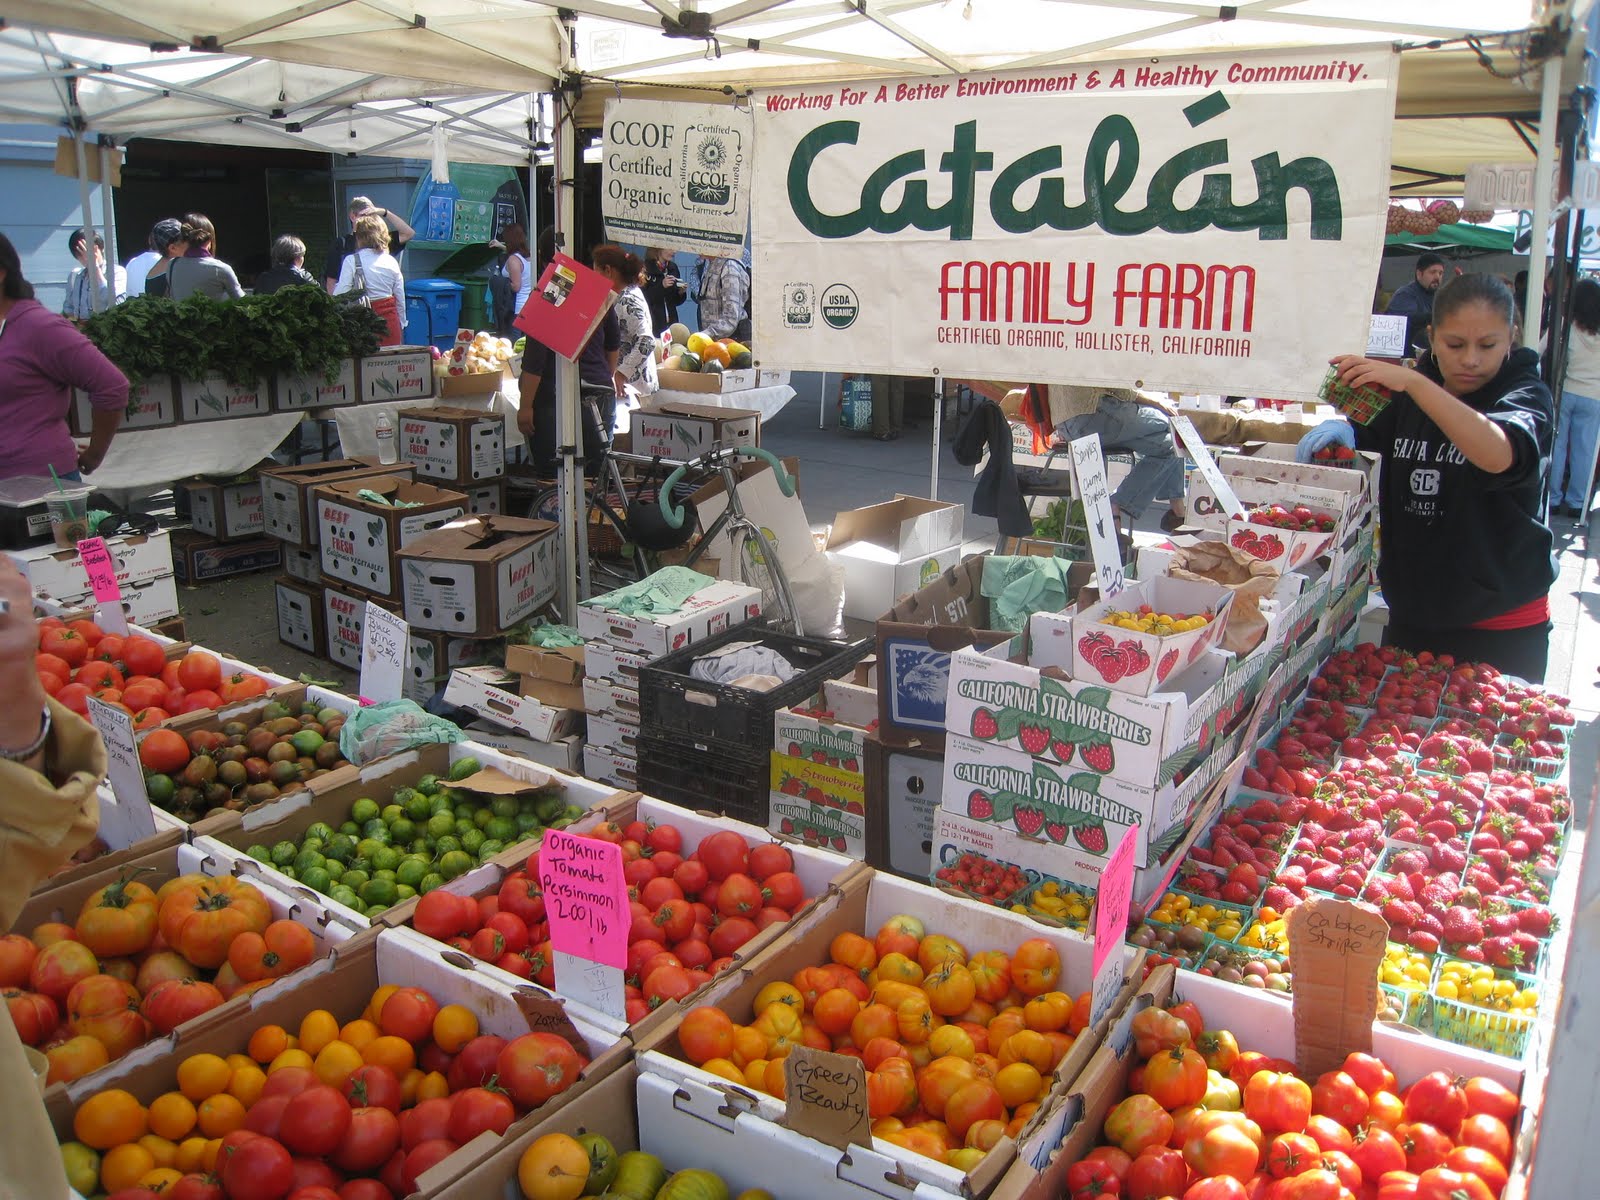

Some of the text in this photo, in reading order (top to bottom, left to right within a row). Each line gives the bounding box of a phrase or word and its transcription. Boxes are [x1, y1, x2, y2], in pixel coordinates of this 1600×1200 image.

[766, 60, 1368, 112] Working For A Better Environment & A Healthy Community.
[610, 121, 674, 149] CCOF
[697, 123, 730, 135] Certified
[609, 153, 672, 178] Certified
[680, 144, 688, 189] California
[733, 153, 743, 191] Organic
[787, 90, 1343, 241] Catalán
[691, 170, 728, 188] CCOF
[608, 179, 672, 208] Organic
[692, 205, 722, 216] Farmers
[829, 295, 850, 305] USDA
[938, 261, 1256, 332] FAMILY FARM
[789, 307, 809, 315] CCOF
[826, 308, 853, 317] ORGANIC
[937, 327, 1251, 358] CERTIFIED ORGANIC, HOLLISTER, CALIFORNIA
[1367, 333, 1404, 348] ample!
[404, 422, 426, 435] BEST
[644, 427, 669, 439] BEST
[409, 444, 428, 456] FRESH
[651, 445, 671, 456] FRESH
[1412, 472, 1435, 492] SC
[323, 507, 350, 523] BEST
[339, 527, 345, 539] &
[332, 536, 354, 555] FRESH
[326, 547, 384, 574] California VEGETABLES
[511, 562, 533, 584] BEST
[517, 585, 535, 604] FRESH
[331, 596, 357, 616] BEST
[345, 617, 351, 628] &
[607, 617, 620, 626] BEST
[615, 655, 628, 664] BEST
[485, 690, 500, 699] BEST
[505, 697, 520, 707] FRESH
[611, 692, 624, 700] BEST
[1127, 697, 1143, 706] Produce
[472, 702, 523, 726] California TOMATOES
[958, 678, 1151, 745] CALIFORNIA STRAWBERRIES
[1184, 686, 1224, 740] CALIFORNIA
[780, 727, 863, 757] CALIFORNIA STRAWBERR
[954, 762, 1142, 826] CALIFORNIA STRAWBERRIES
[773, 803, 862, 840] CALIFORNIA STRAWBERRIES
[960, 826, 993, 841] CLAMSHELLS
[971, 837, 993, 850] BASKETS
[550, 834, 605, 860] Organic
[549, 858, 604, 883] Tomato
[1074, 861, 1102, 874] PRODUCE
[543, 874, 614, 910] Persimmon
[1308, 926, 1362, 956] Stripe
[795, 1060, 858, 1095] Green
[796, 1083, 864, 1135] Beauty
